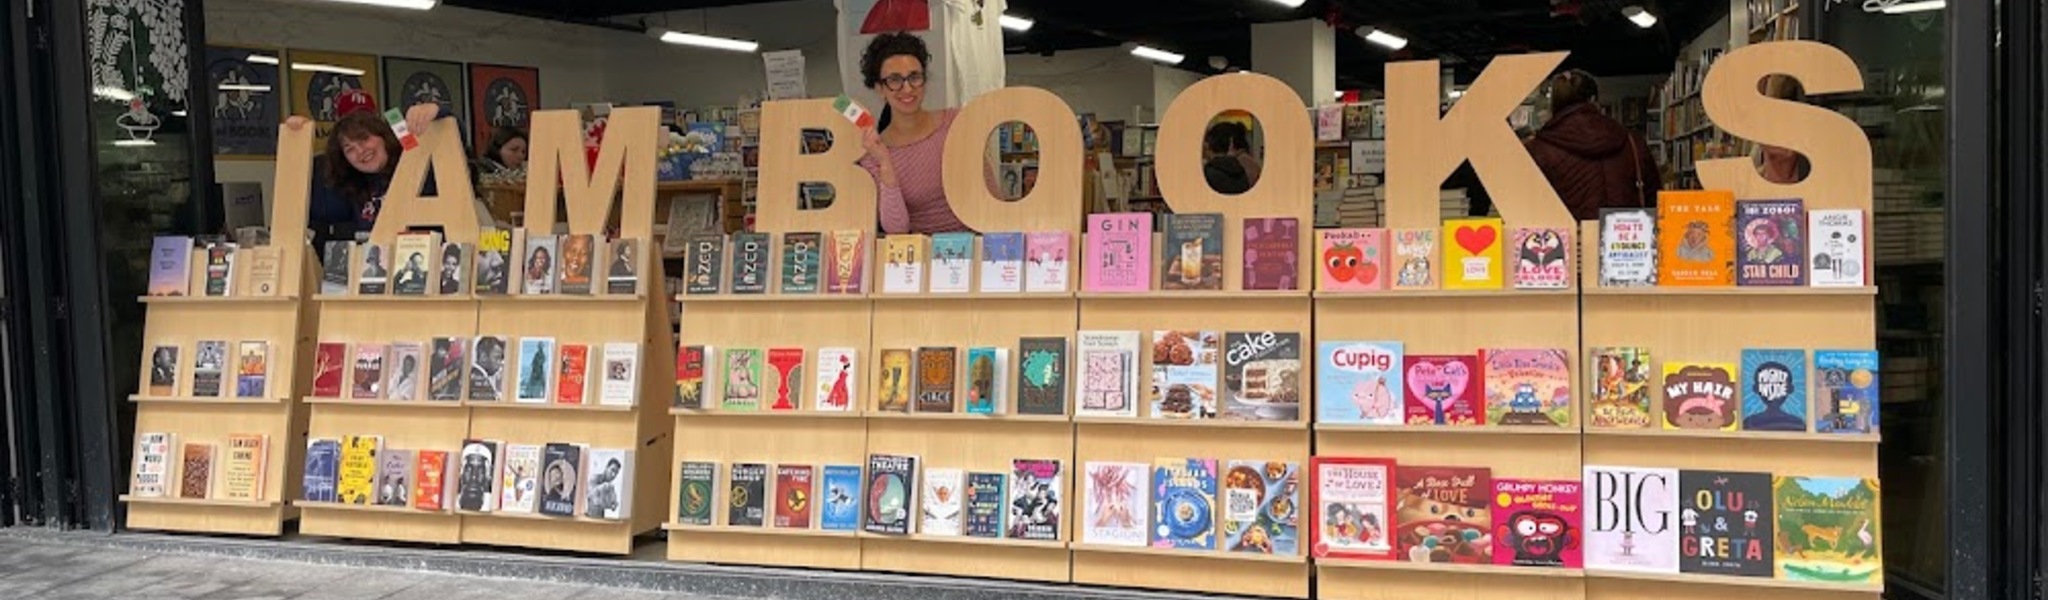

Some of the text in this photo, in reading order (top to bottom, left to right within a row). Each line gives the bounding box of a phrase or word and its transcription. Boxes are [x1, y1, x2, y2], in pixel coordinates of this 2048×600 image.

[371, 105, 662, 240] AM
[757, 40, 1874, 238] BOOKS
[1101, 219, 1139, 231] GIN
[477, 229, 511, 252] KING
[1397, 229, 1433, 244] LOVE
[1522, 266, 1563, 274] LOVE
[1743, 264, 1799, 279] STAR CHILD
[1226, 331, 1277, 366] cake
[1332, 349, 1390, 372] Cupig
[1414, 364, 1436, 377] Pete
[919, 391, 952, 404] CIRCE
[1666, 381, 1734, 400] MY HAIR
[1344, 467, 1379, 479] HOUSE
[1345, 479, 1375, 490] LOVE
[1496, 483, 1578, 493] GRUMPY MONKEY
[1433, 487, 1469, 503] LOVE
[1592, 471, 1672, 534] BIG
[1696, 489, 1744, 511] OLU
[1713, 516, 1728, 531] &
[1682, 535, 1762, 561] GRETA
